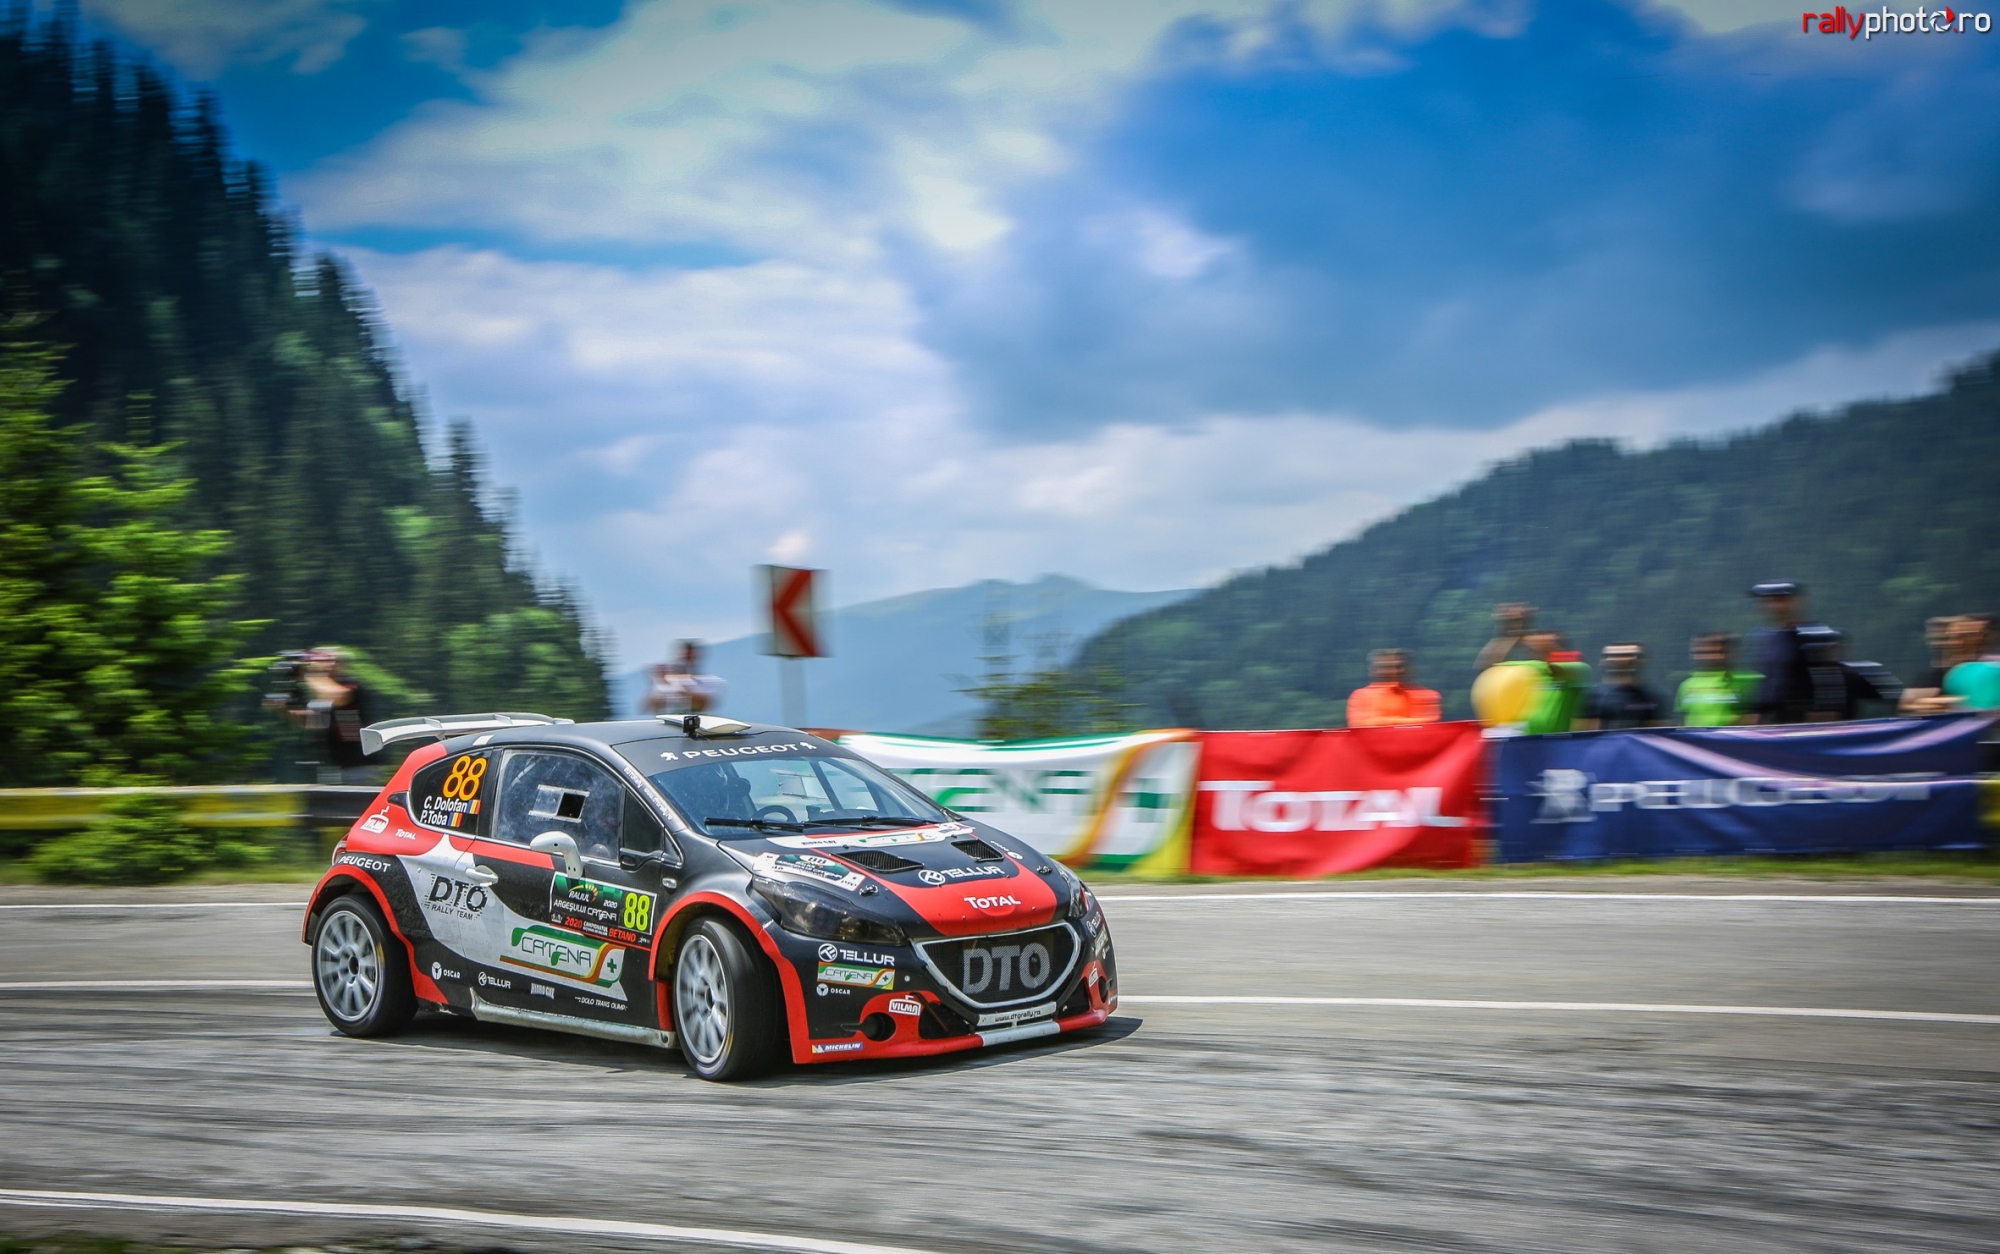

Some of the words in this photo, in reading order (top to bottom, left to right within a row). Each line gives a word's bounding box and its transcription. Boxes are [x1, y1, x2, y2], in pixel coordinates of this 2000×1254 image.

[682, 743, 799, 759] PEUGEOT
[443, 755, 487, 801] 88
[423, 795, 433, 810] C.
[434, 796, 468, 813] Dolofan
[1202, 781, 1467, 833] TOTAL
[395, 829, 416, 840] TOTAL
[338, 855, 391, 872] PEUGEOT
[940, 865, 1005, 878] TELLUR
[429, 875, 488, 912] DTO
[603, 899, 618, 909] 2020
[964, 895, 1021, 909] TOTAL
[431, 904, 454, 915] RALLY
[456, 910, 473, 921] TEAM
[587, 907, 617, 921] CATENA
[624, 892, 650, 931] 88
[565, 917, 583, 928] 2020
[608, 927, 637, 942] BETANO
[521, 936, 592, 968] CATENA
[840, 949, 895, 966] TELLUR
[443, 969, 460, 979] OSCAR
[825, 968, 873, 981] CATENA
[962, 942, 1050, 994] DTO
[487, 976, 511, 989] TELLUR
[891, 1002, 919, 1013] VILMA
[824, 1043, 861, 1051] MICHELIN
